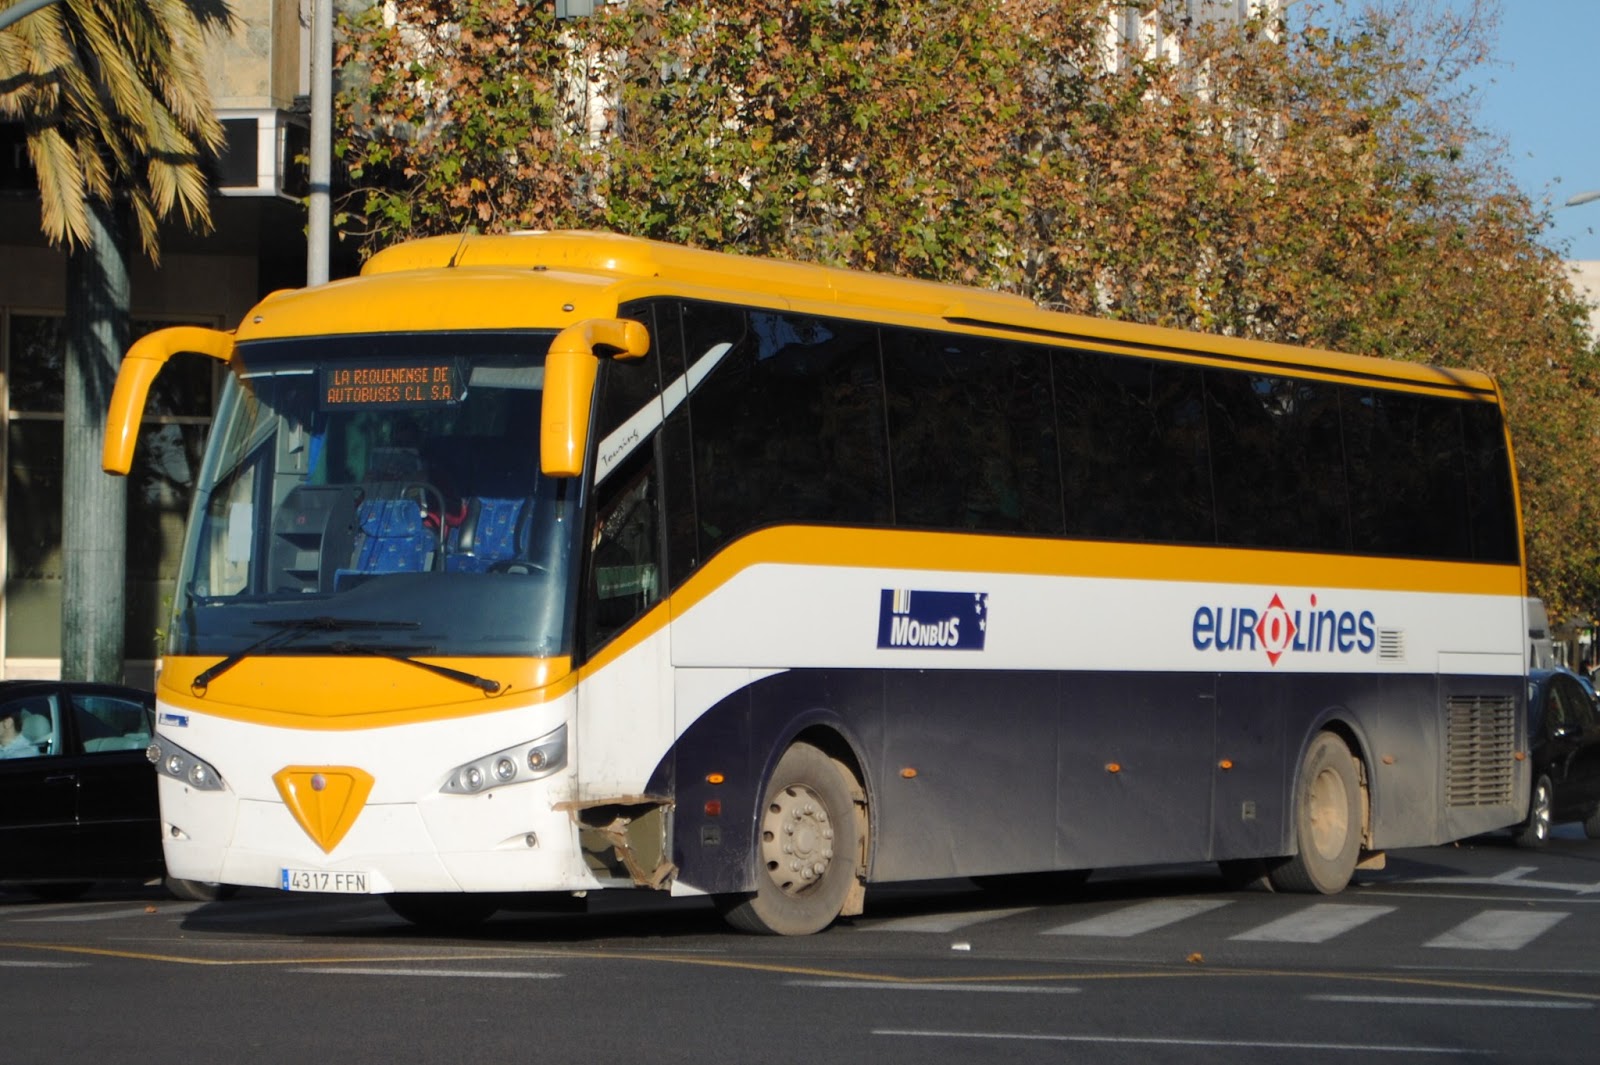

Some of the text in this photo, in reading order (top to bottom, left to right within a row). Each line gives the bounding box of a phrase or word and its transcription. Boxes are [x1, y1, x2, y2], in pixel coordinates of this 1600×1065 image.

[334, 369, 350, 386] LA
[432, 366, 449, 383] DE
[327, 386, 400, 403] AUTOBUSES
[430, 385, 454, 400] S.A.
[601, 429, 640, 467] Touring
[890, 616, 960, 647] MONBUS
[291, 872, 330, 890] 4317
[335, 873, 367, 892] FFN
